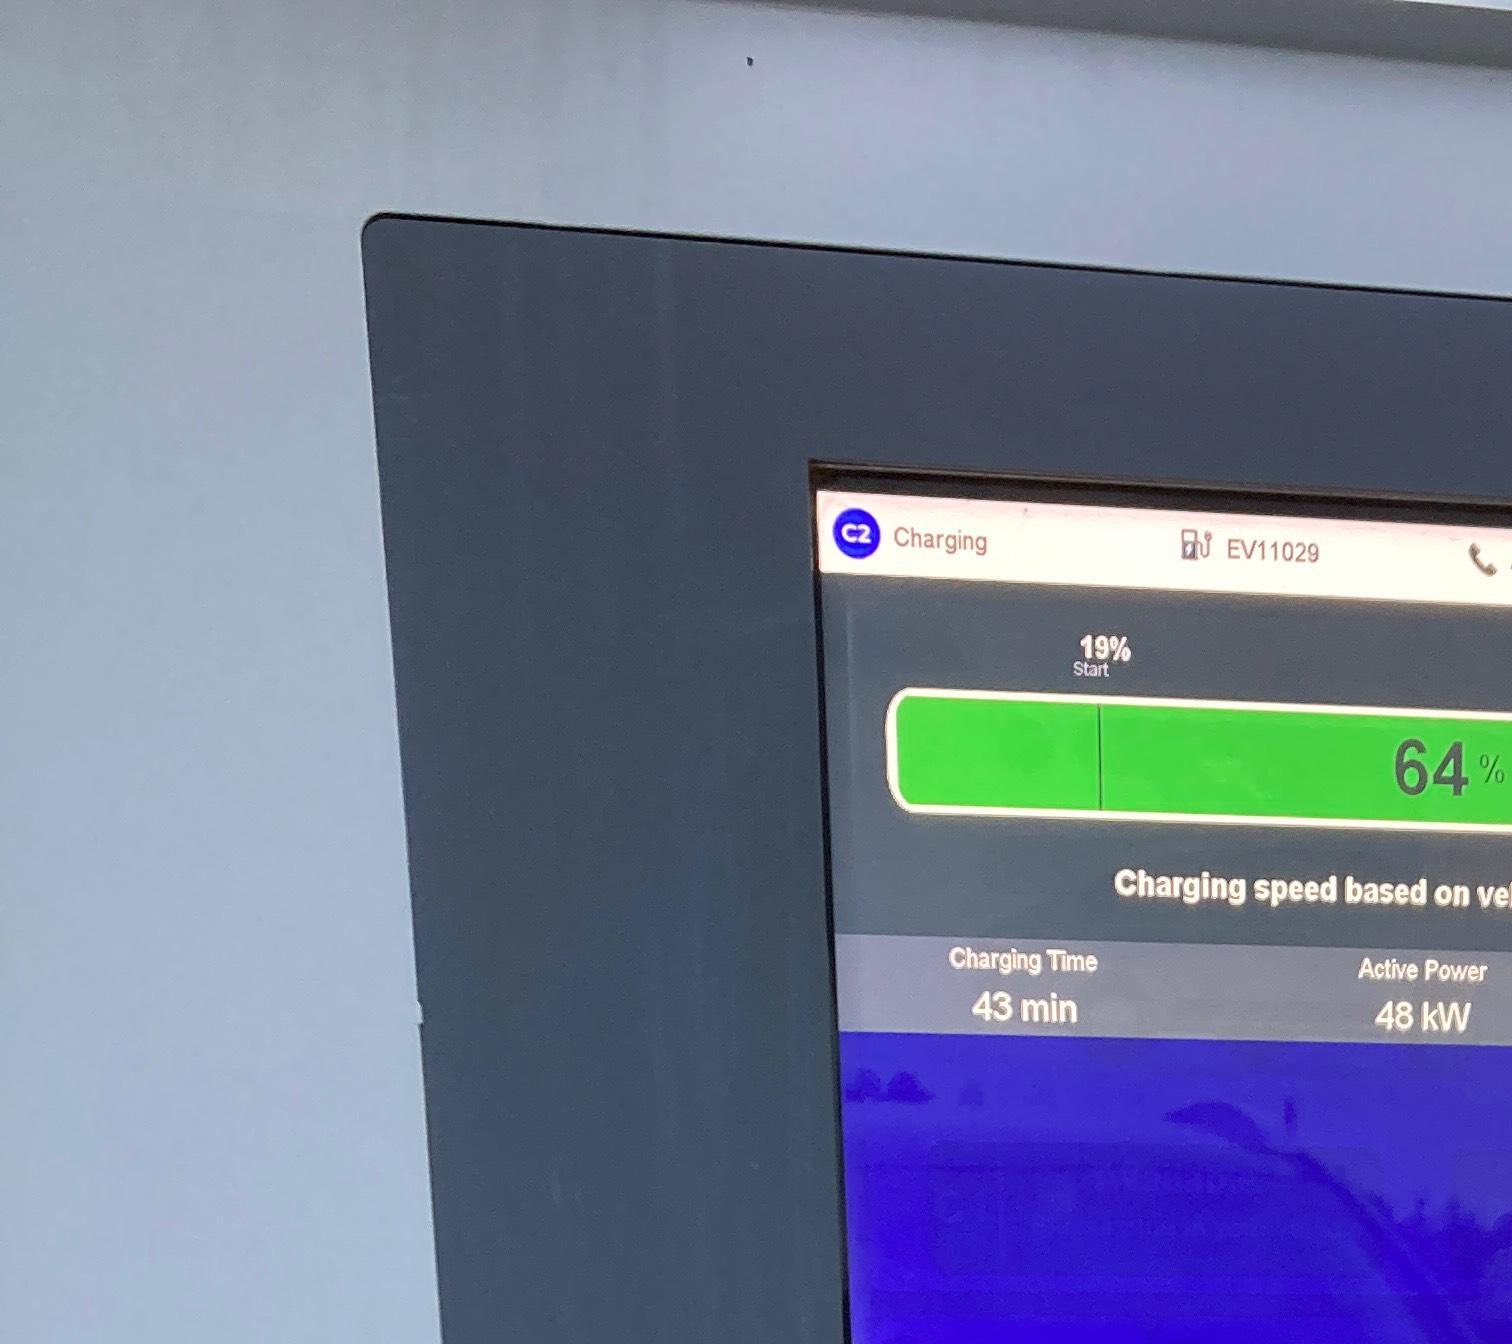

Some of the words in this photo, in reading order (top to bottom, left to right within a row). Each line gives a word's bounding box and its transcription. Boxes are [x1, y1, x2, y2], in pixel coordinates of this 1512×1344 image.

[840, 523, 873, 545] C2
[893, 526, 988, 555] Charging
[1226, 539, 1320, 563] EV11029
[1079, 634, 1132, 662] 19%
[1073, 660, 1110, 677] Start
[1393, 738, 1469, 797] 64
[1479, 754, 1505, 785] %
[1114, 868, 1247, 904] Charging
[1253, 873, 1336, 906] speed
[1345, 875, 1428, 906] based
[1434, 884, 1469, 908] on
[948, 947, 1041, 974] Charging
[1046, 948, 1099, 972] Time
[1358, 957, 1419, 981] Active
[1425, 960, 1488, 983] Power
[971, 991, 1013, 1021] 43
[1019, 993, 1079, 1023] min
[1375, 1001, 1414, 1031] 48
[1420, 1001, 1471, 1032] kW
